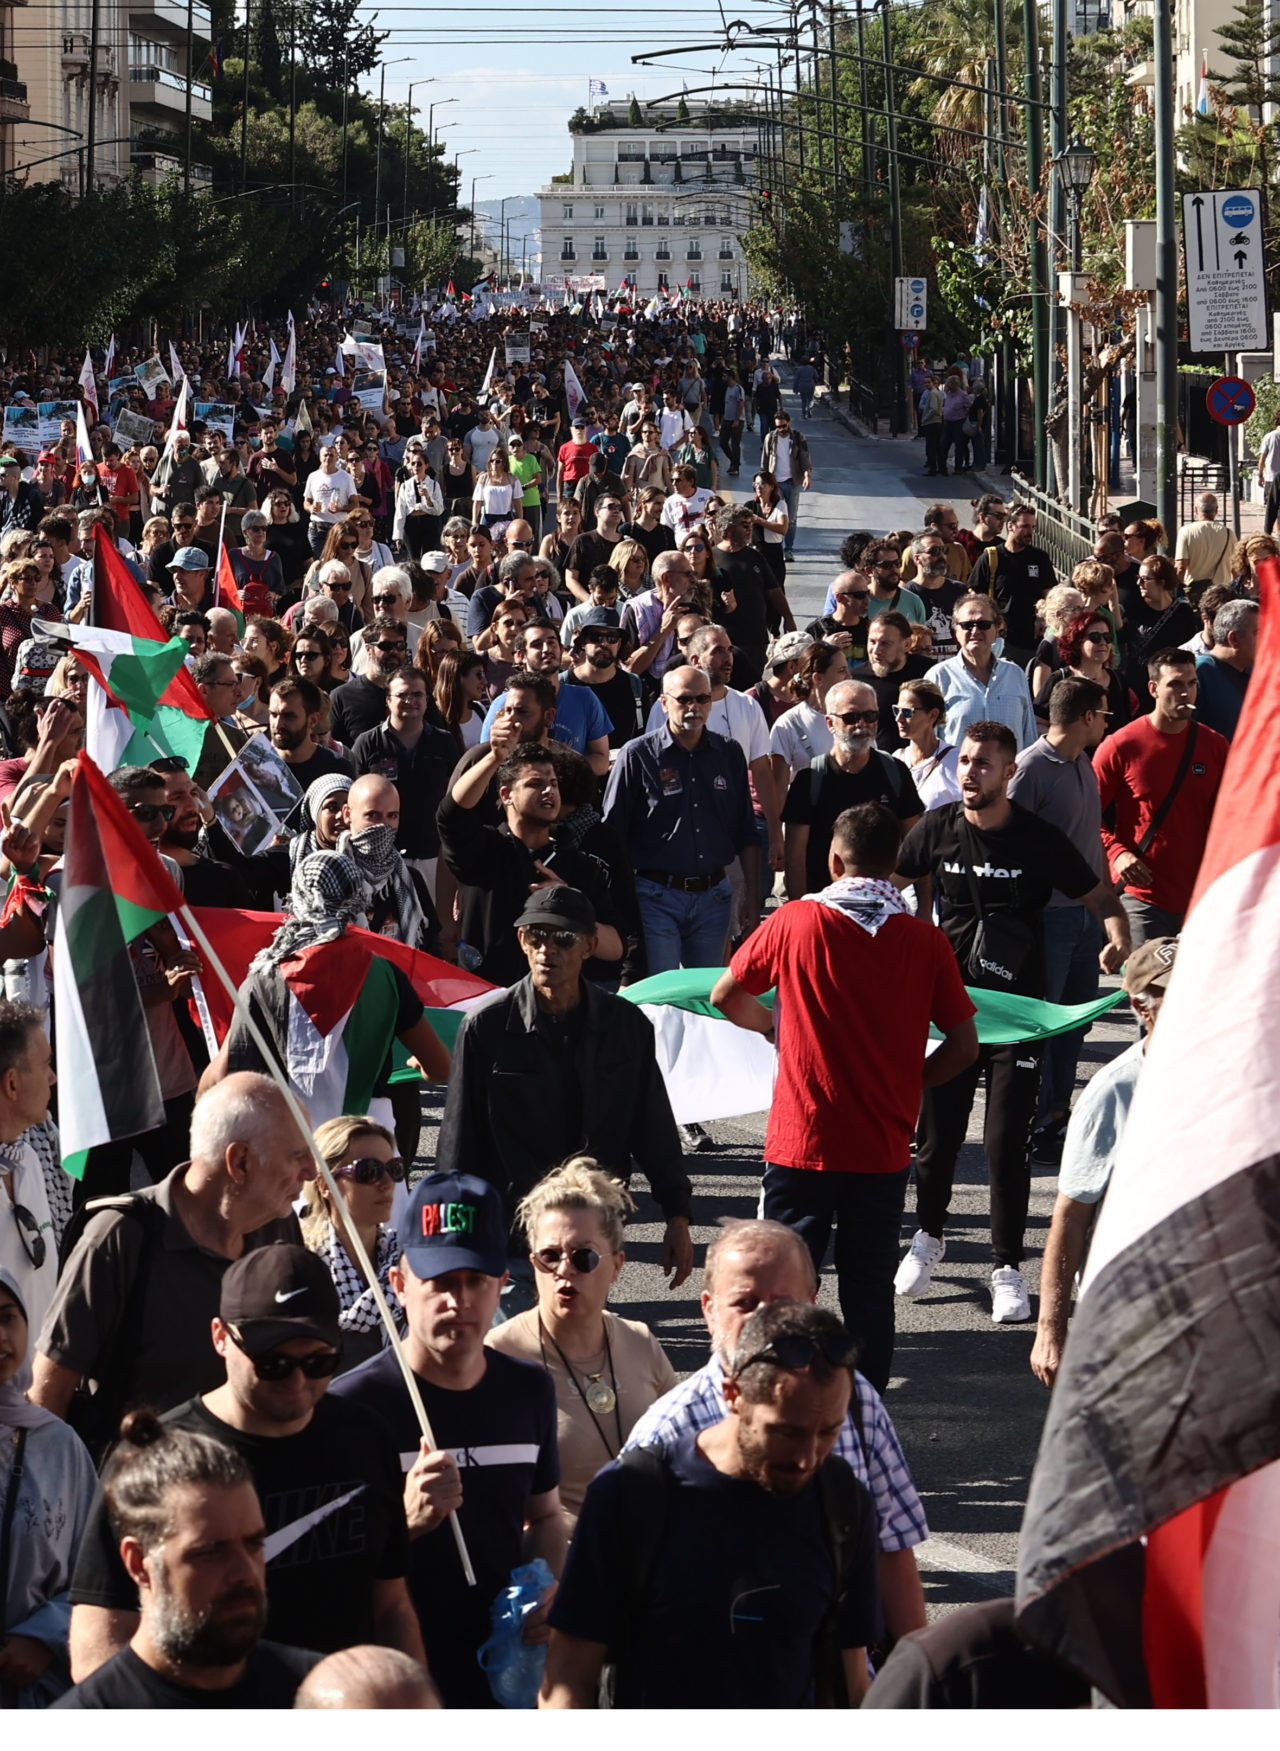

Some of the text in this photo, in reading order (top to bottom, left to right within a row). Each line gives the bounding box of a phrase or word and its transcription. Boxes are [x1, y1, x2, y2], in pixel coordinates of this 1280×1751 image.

[979, 957, 1013, 982] adidas
[1016, 1059, 1036, 1070] PUMA
[421, 1203, 477, 1237] PALEST
